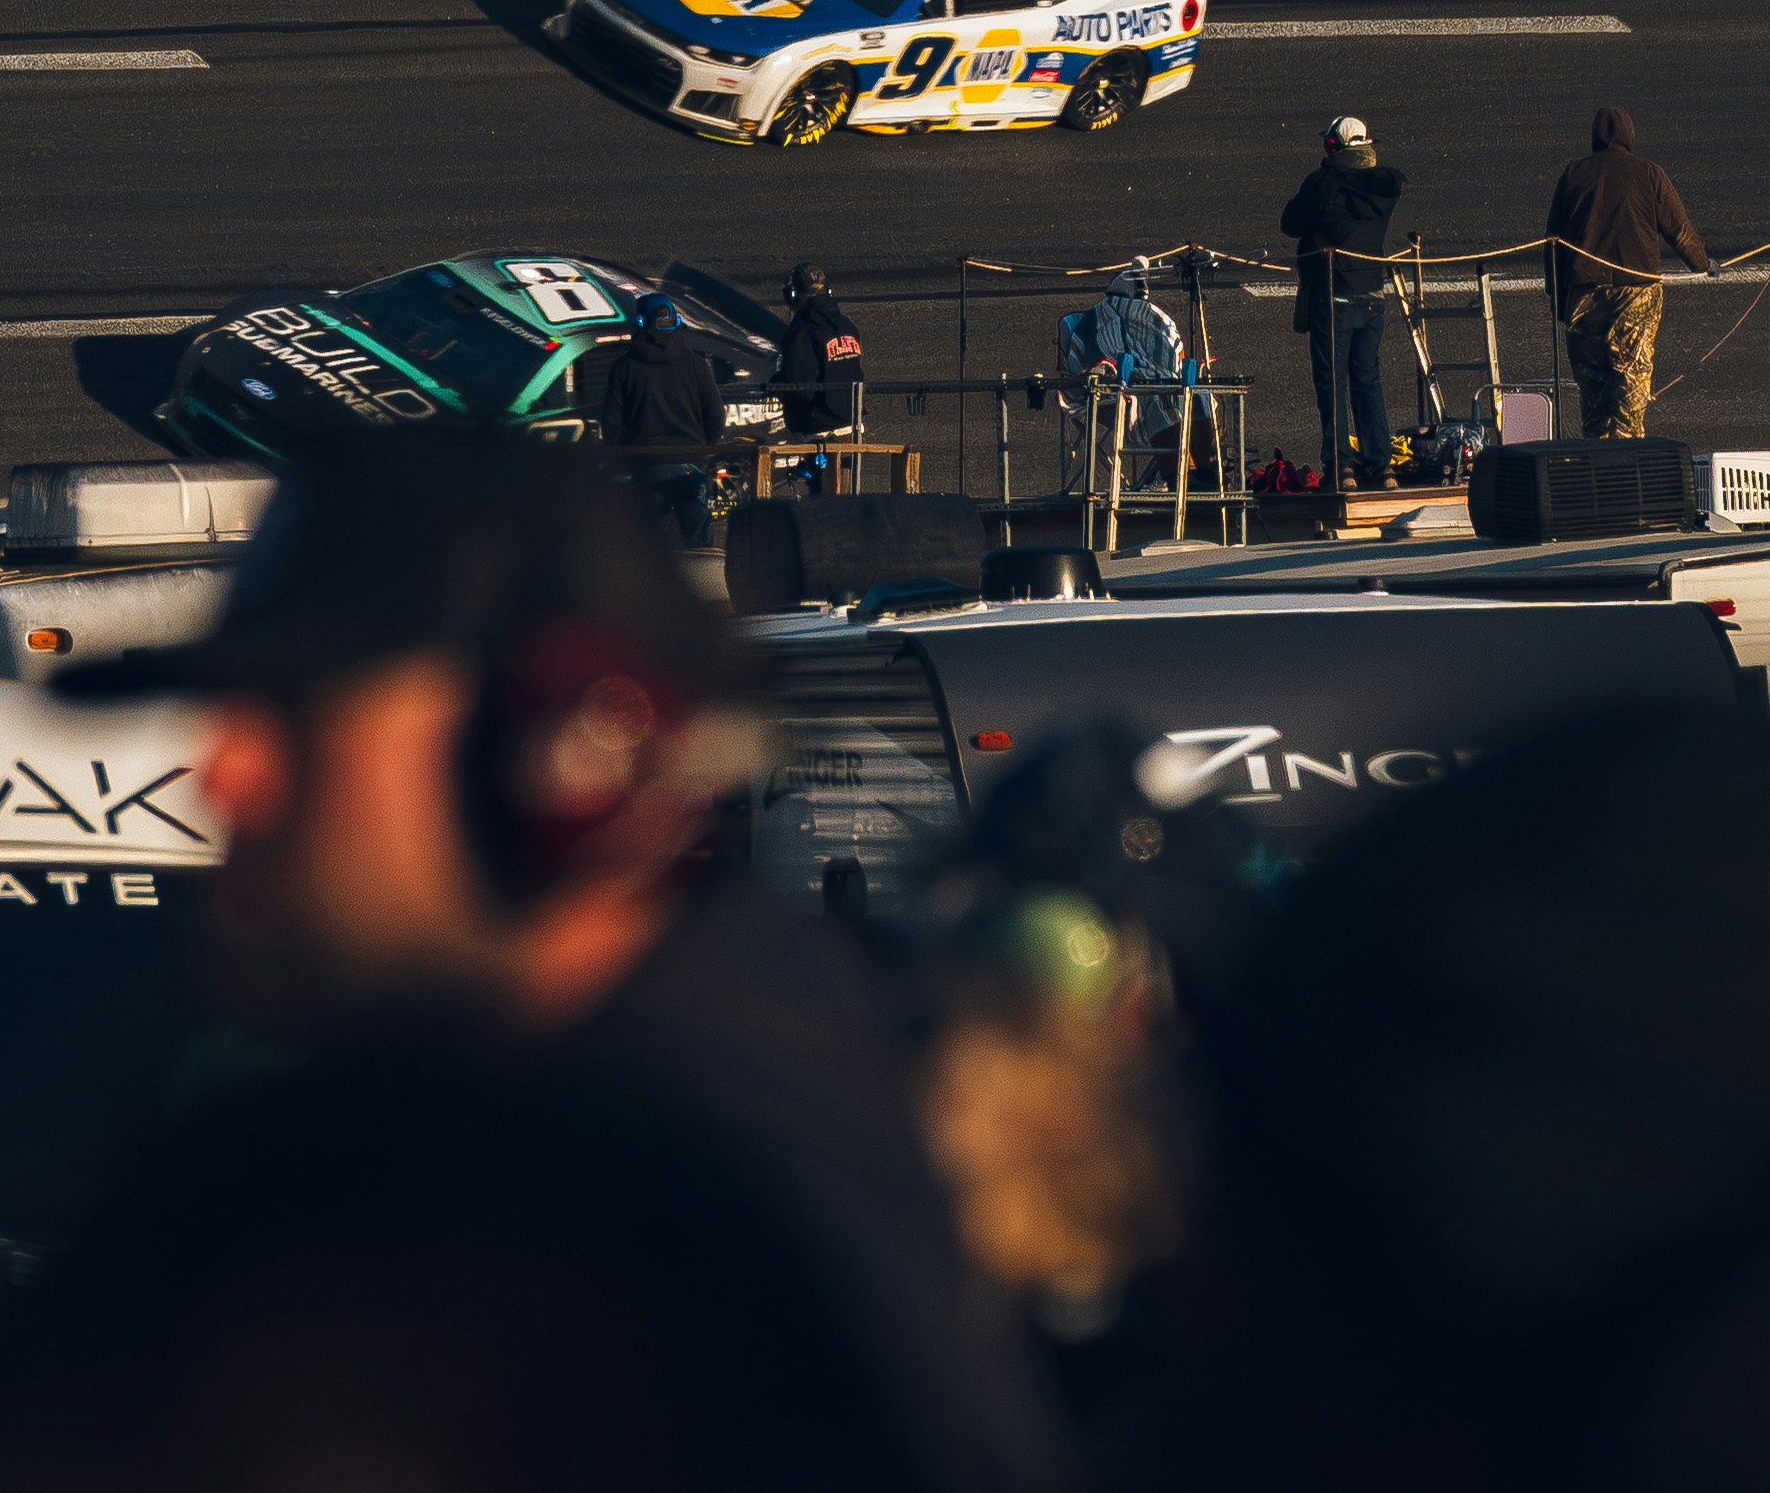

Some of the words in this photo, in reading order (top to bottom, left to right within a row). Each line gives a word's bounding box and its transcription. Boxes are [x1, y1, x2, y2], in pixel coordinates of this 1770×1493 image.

[1052, 12, 1111, 42] AUTO
[1115, 2, 1173, 40] PARTS
[870, 32, 960, 102] 9
[243, 306, 437, 419] BUILD
